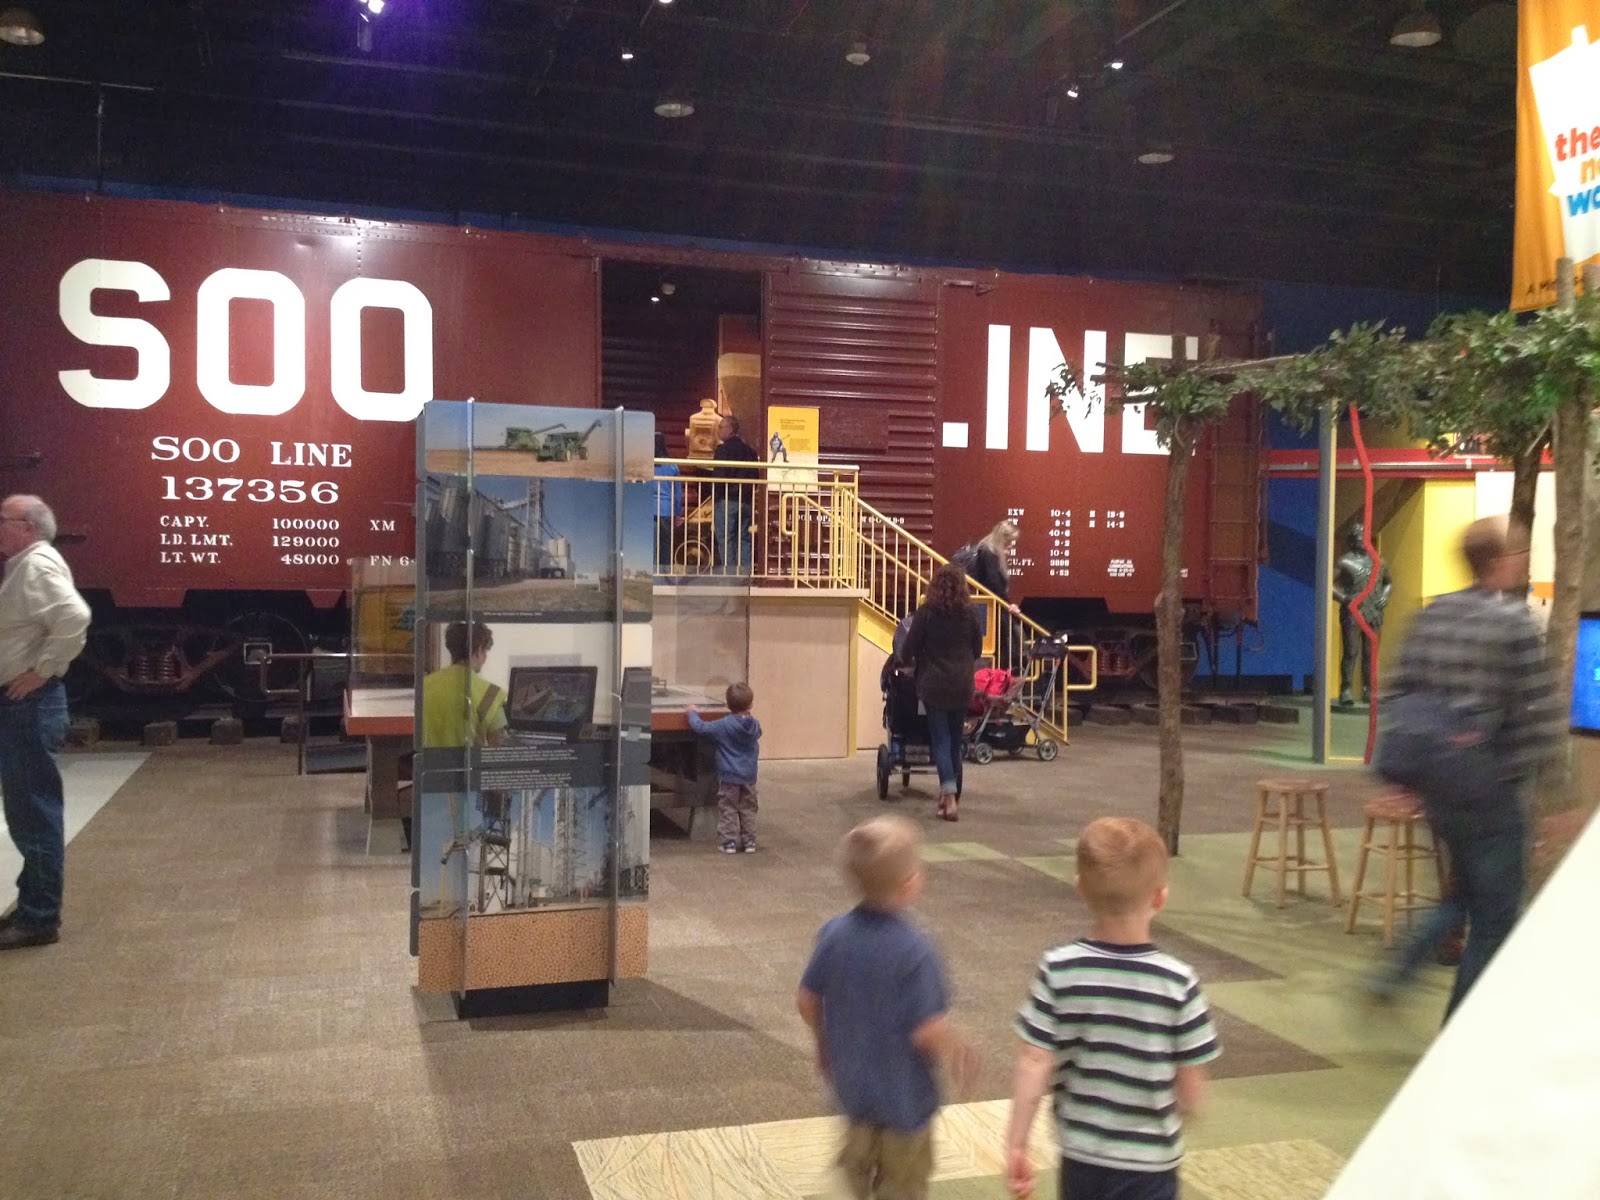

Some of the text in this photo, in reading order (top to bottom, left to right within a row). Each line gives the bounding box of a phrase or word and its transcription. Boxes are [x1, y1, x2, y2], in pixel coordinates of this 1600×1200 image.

[58, 258, 434, 422] SOO
[151, 436, 353, 468] SOO LINE
[161, 475, 339, 505] 137356
[160, 515, 396, 532] CAPY. 100000 XM
[160, 533, 340, 548] LD. LMT. 129000
[160, 552, 187, 564] LT.
[190, 552, 222, 564] WT.
[280, 553, 340, 566] 48000
[370, 555, 393, 567] FN
